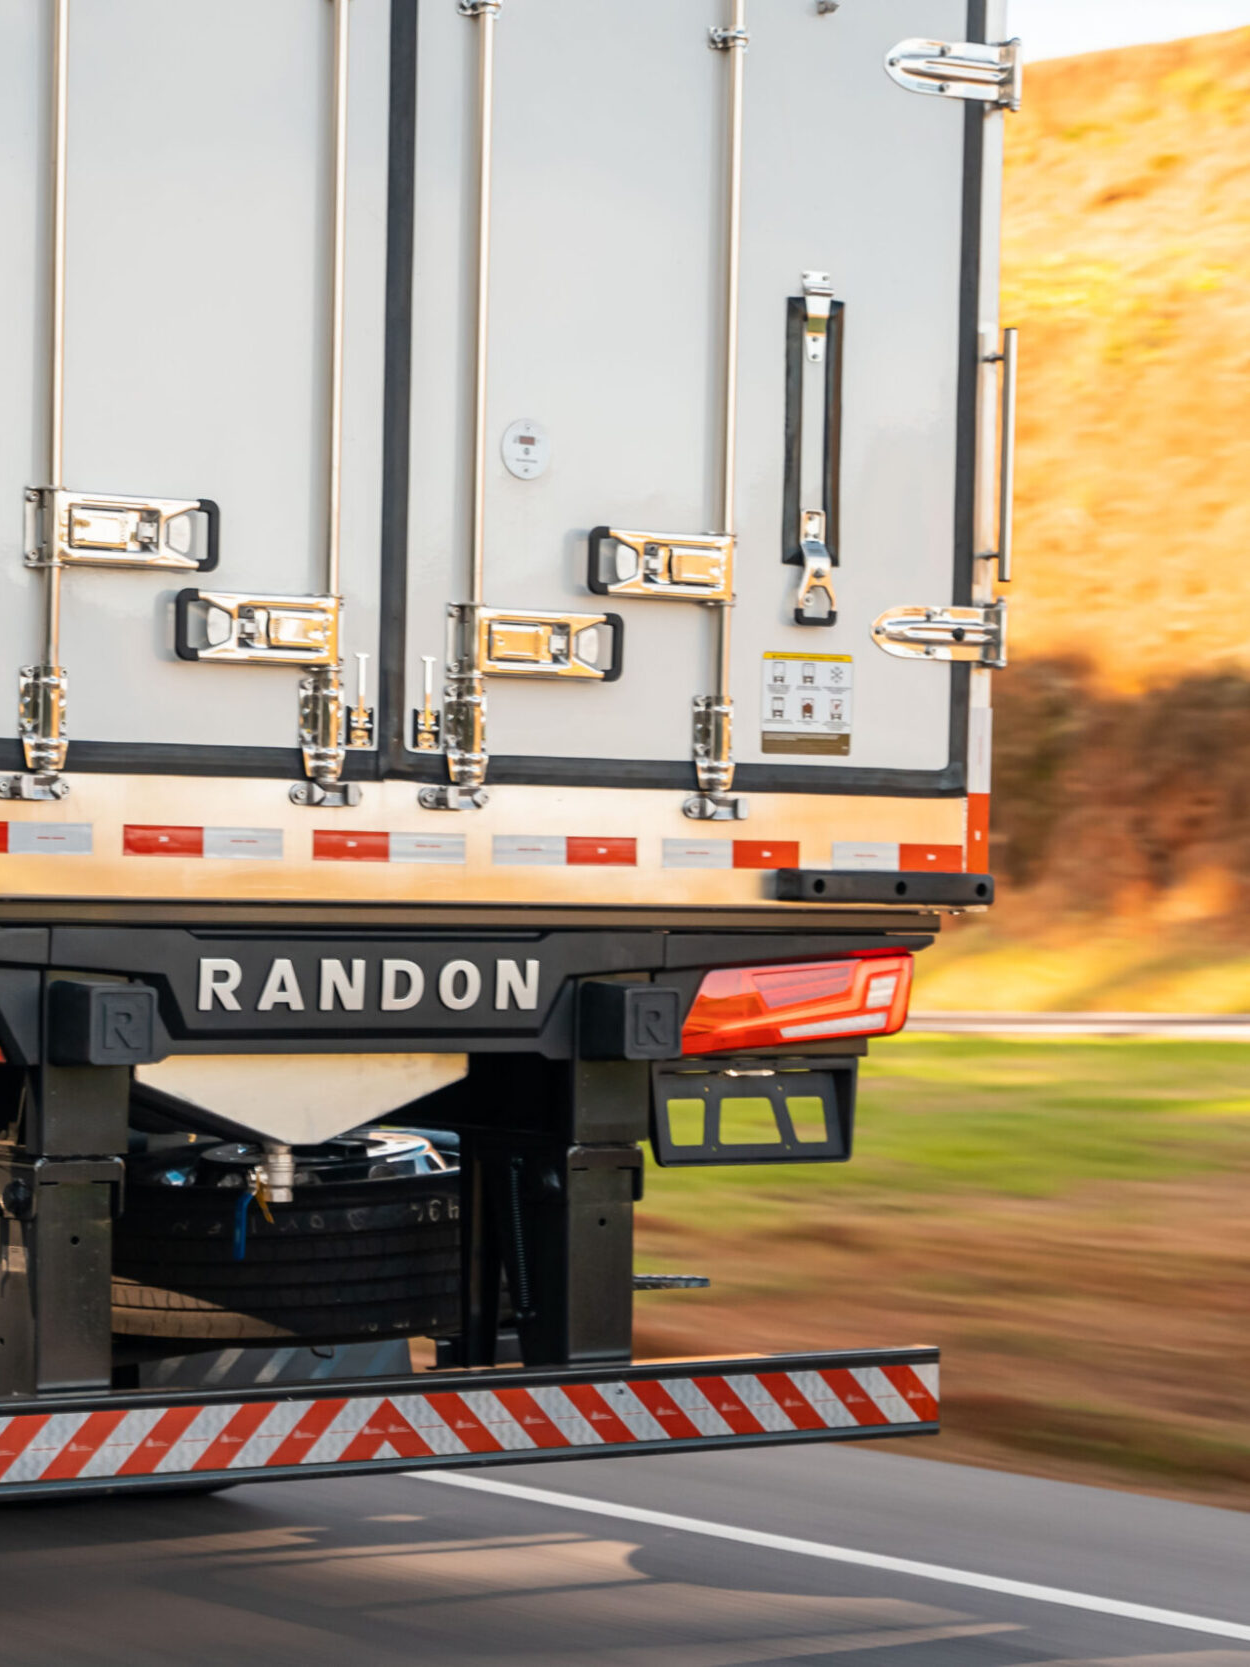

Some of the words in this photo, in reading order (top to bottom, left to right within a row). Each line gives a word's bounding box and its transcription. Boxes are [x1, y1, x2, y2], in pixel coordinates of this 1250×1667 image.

[199, 958, 540, 1011] RANDON
[103, 1002, 143, 1050] R
[635, 1001, 670, 1046] R
